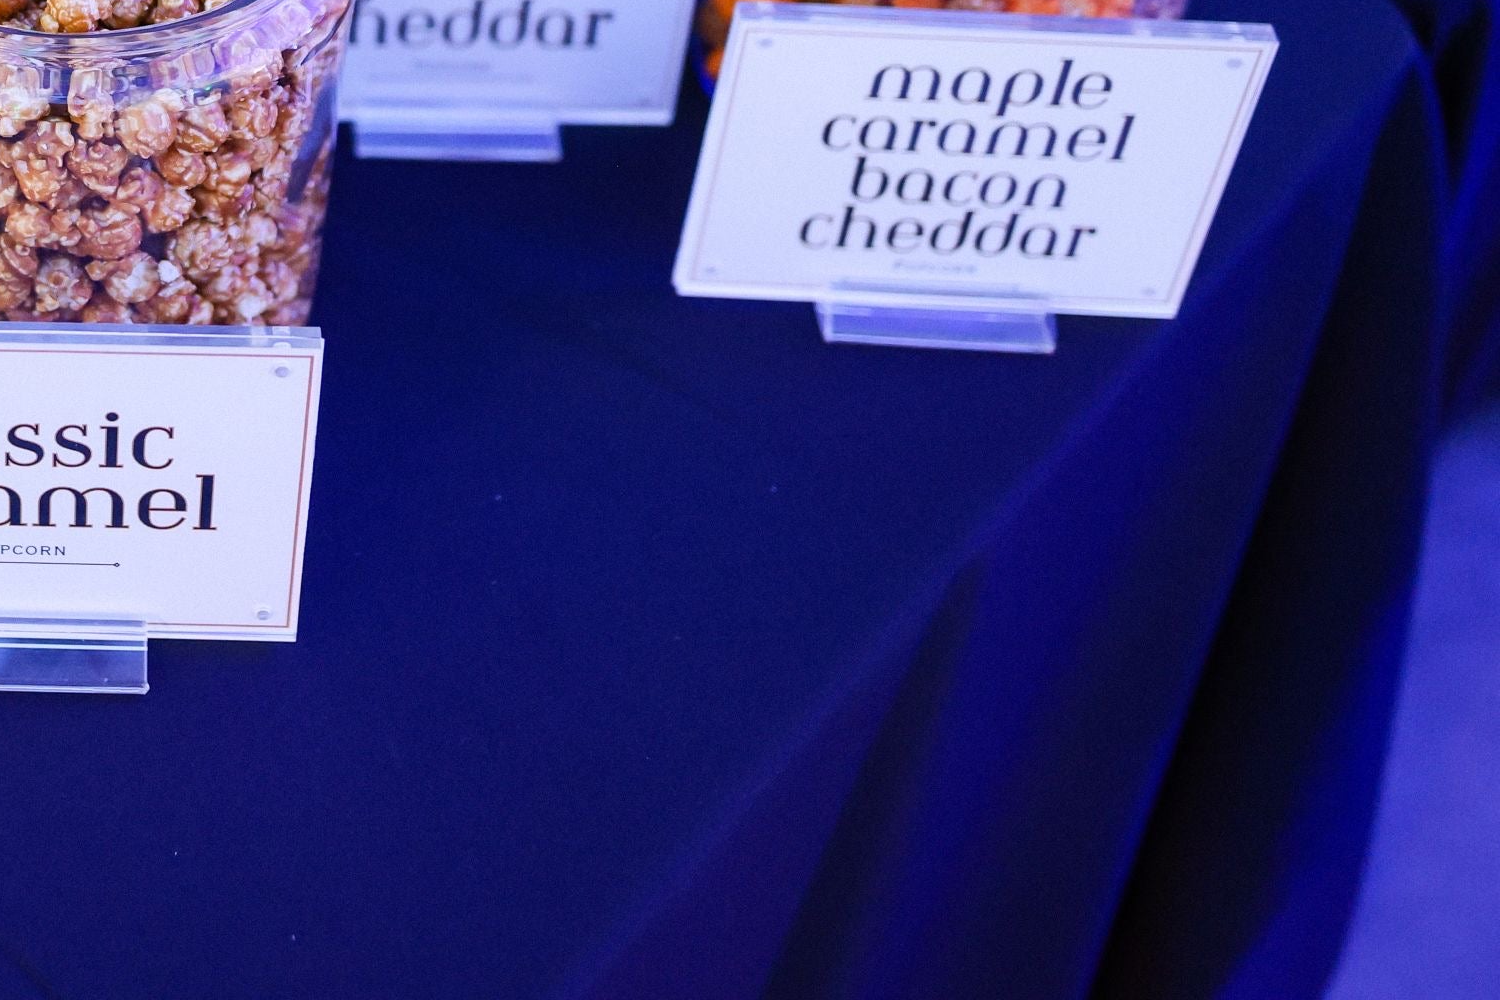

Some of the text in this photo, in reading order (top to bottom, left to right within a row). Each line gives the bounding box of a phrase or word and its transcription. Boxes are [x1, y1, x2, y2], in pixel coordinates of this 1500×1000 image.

[348, 0, 614, 51] heddar
[866, 58, 1113, 118] maple
[821, 113, 1136, 162] caramel
[850, 155, 1068, 210] bacon
[799, 205, 1097, 261] cheddar
